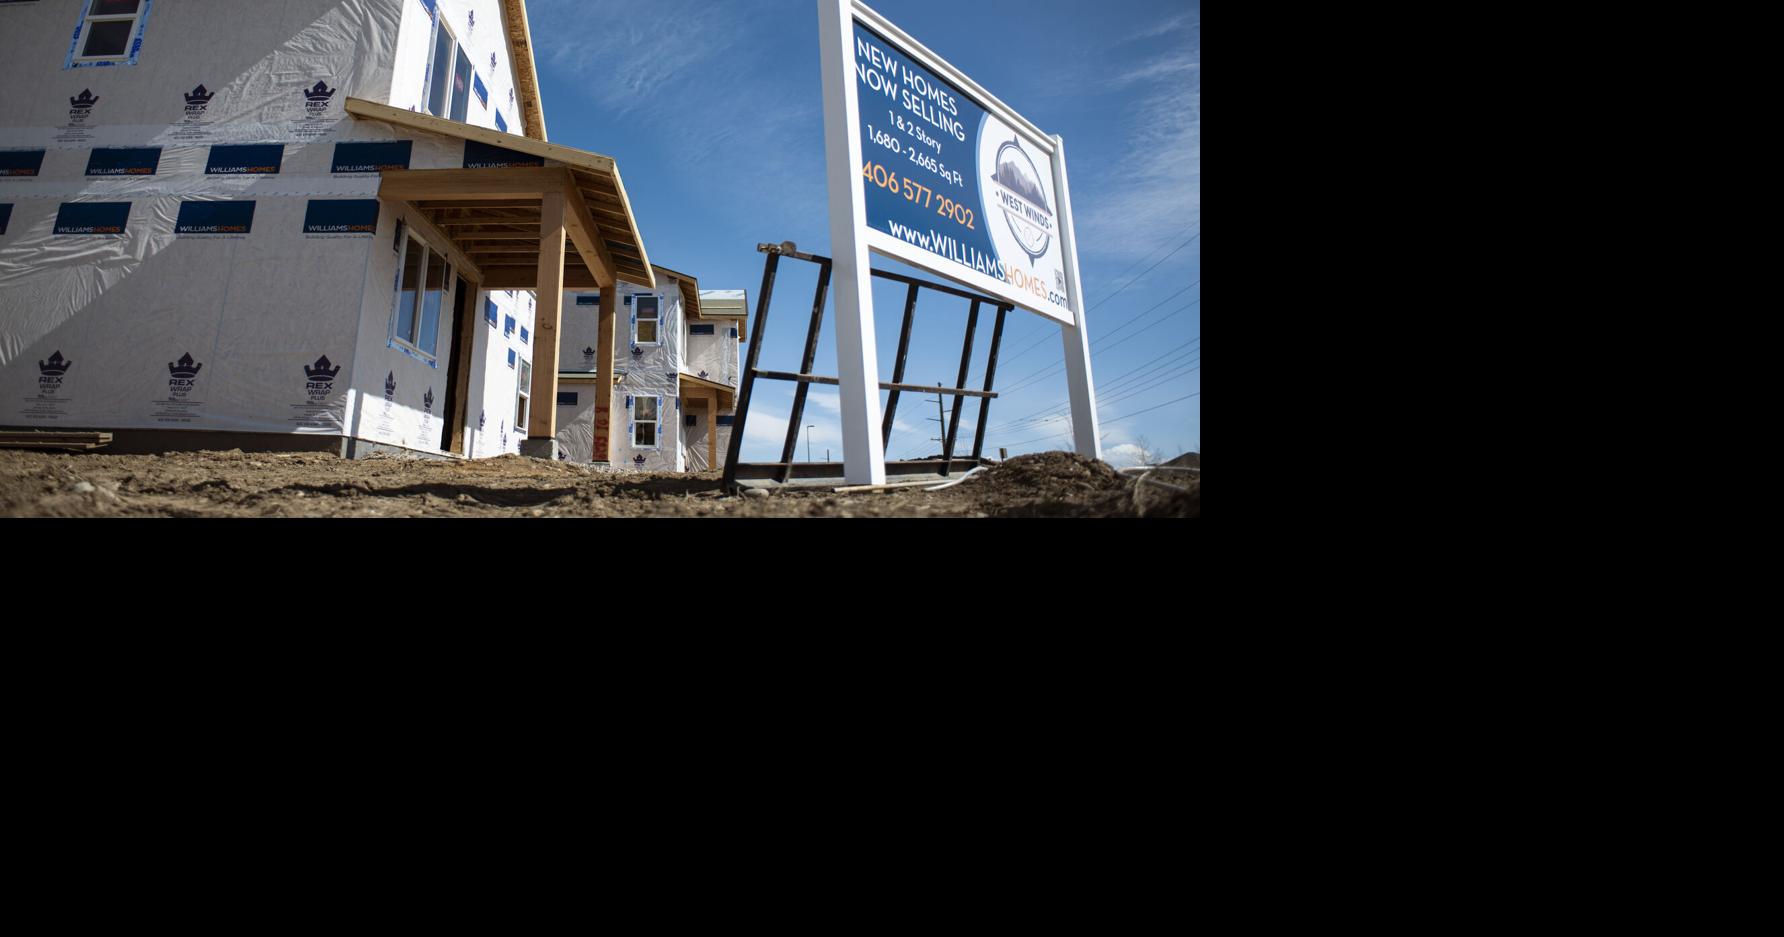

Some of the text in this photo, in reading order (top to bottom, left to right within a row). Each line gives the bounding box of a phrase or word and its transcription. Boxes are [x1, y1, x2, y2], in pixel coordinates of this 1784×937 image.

[855, 61, 965, 142] NOW SELLING
[857, 36, 958, 116] NEW HOMES
[868, 124, 900, 153] 1,680
[908, 147, 937, 173] 2,665
[939, 164, 952, 184] Sq
[953, 171, 963, 187] Ft
[889, 110, 941, 154] 1 & 2 Story
[862, 160, 975, 230] 406 577 2902
[1000, 189, 1050, 230] WEST WINDS
